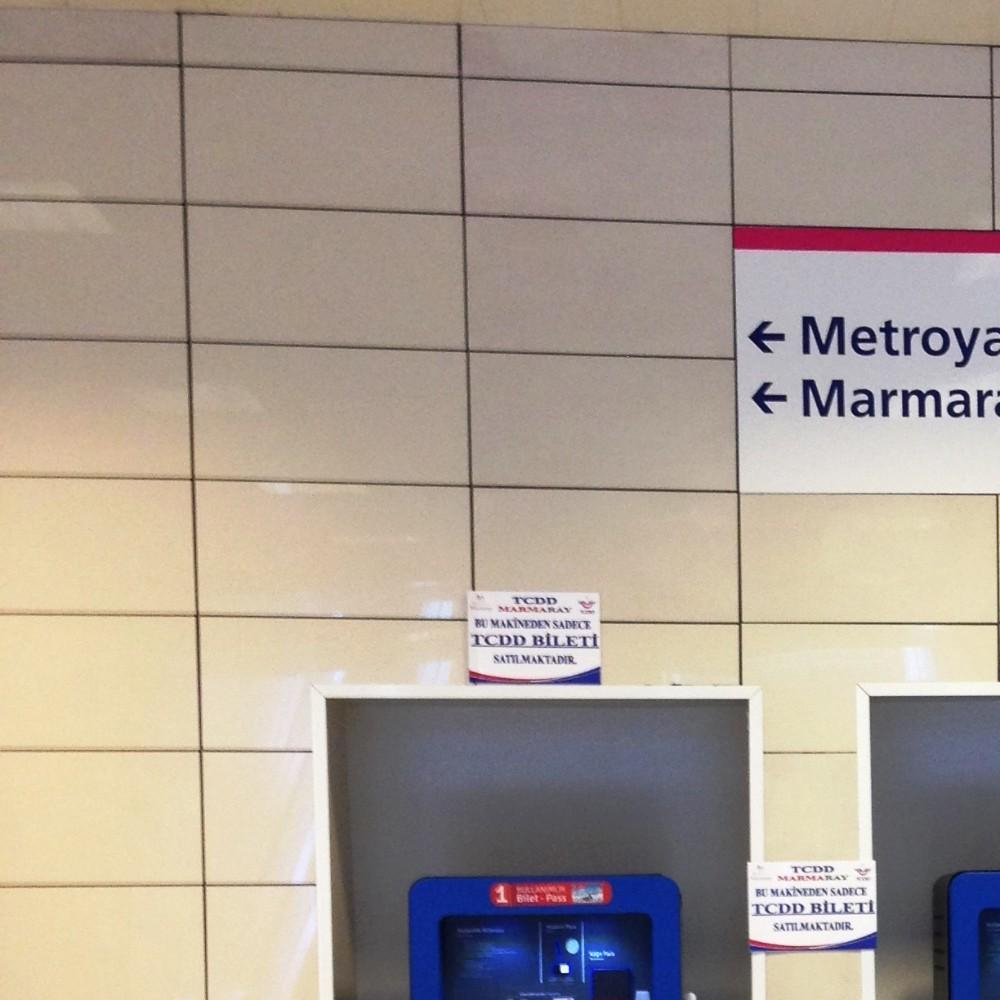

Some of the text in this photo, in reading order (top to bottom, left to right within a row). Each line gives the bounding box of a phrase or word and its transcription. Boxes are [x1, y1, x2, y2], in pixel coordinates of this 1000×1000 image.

[512, 597, 557, 605] TCDD
[475, 617, 592, 630] BU MAKİNEDEN SADECE
[471, 632, 599, 647] TCDD BİLETİ
[495, 885, 508, 904] 1
[755, 886, 868, 897] BU MAKİNEDEN SADECE
[516, 893, 539, 904] Bilet
[752, 900, 875, 915] TCDD BİLETİ
